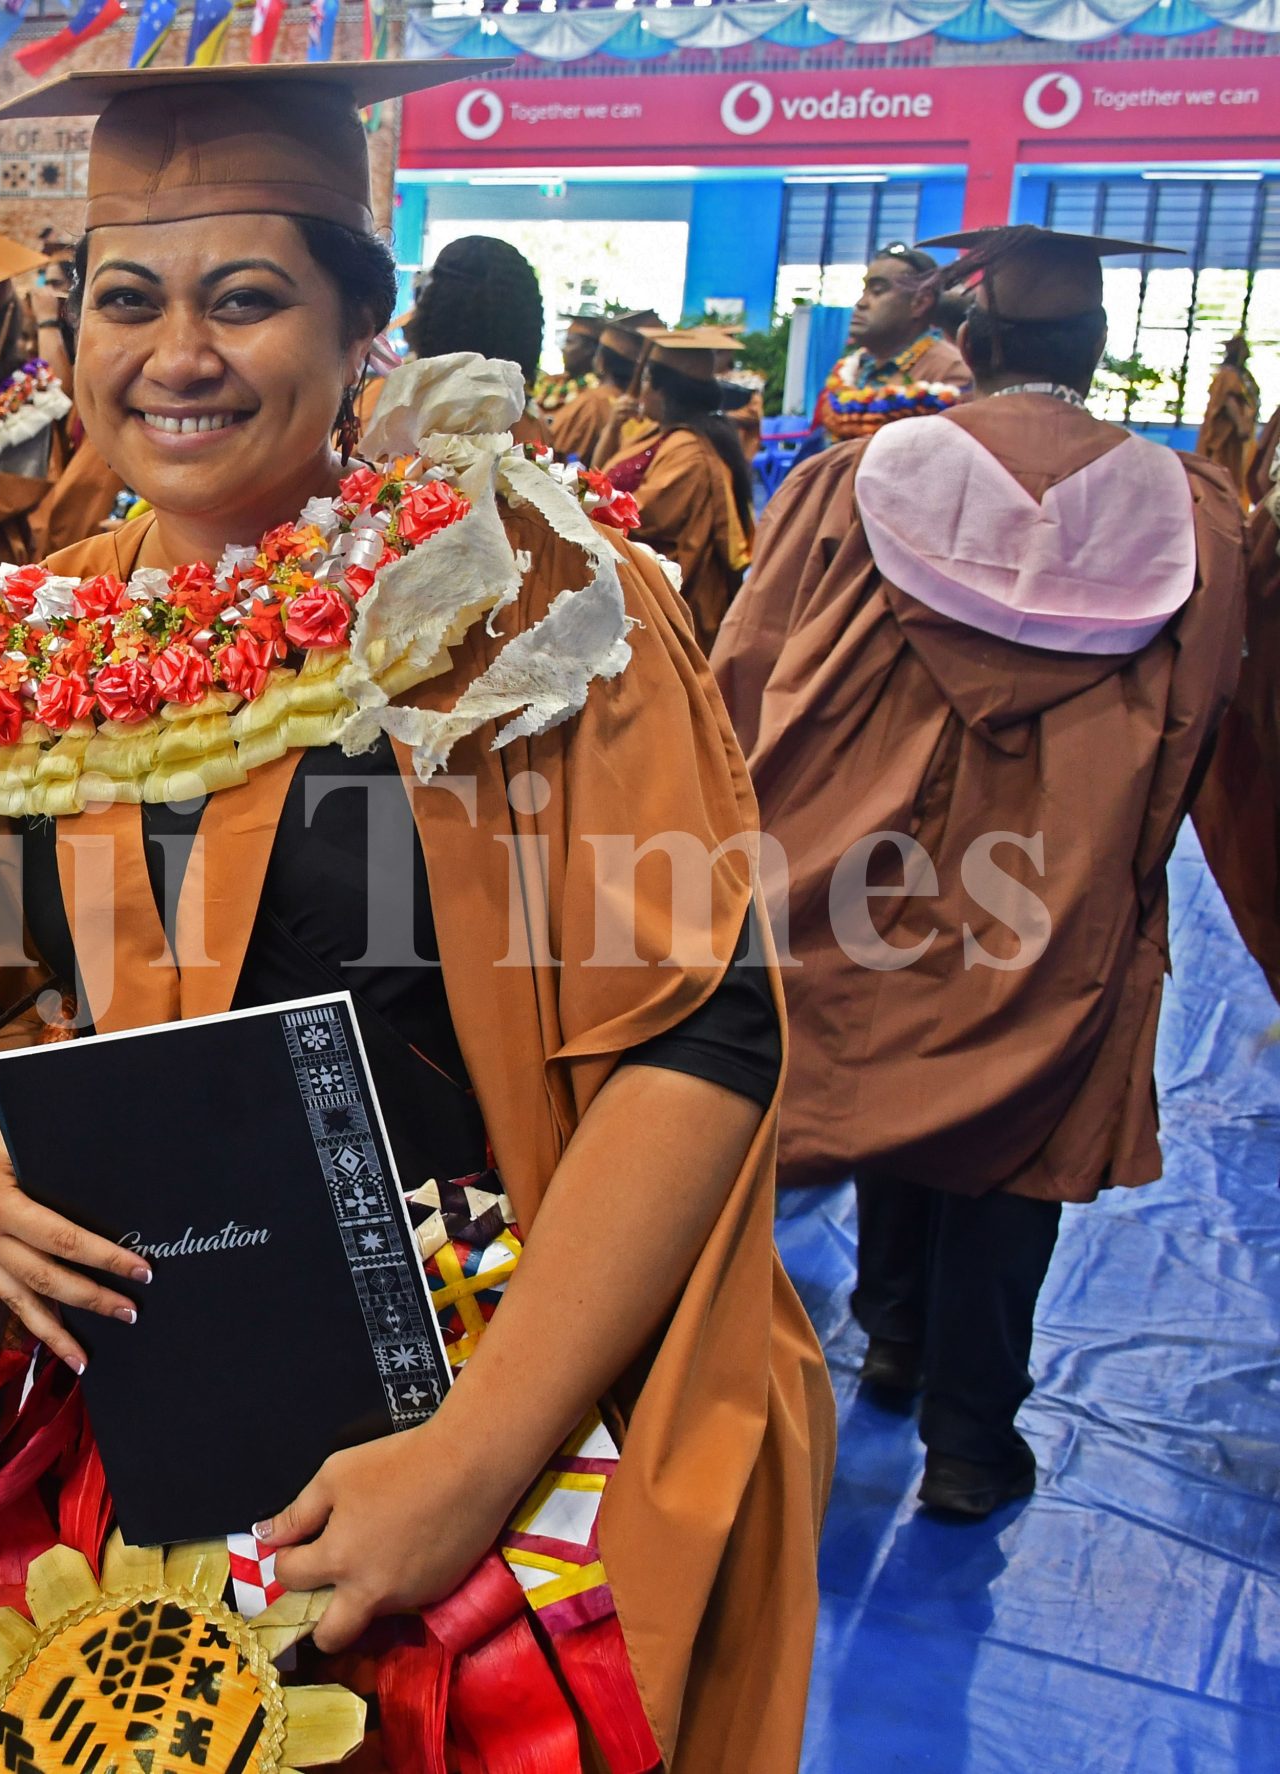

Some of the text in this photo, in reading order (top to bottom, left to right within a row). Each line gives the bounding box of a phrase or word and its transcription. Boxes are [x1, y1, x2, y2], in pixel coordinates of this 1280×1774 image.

[509, 102, 642, 124] Together we can
[781, 88, 933, 120] vodafone
[1091, 87, 1259, 111] Together we can
[117, 1220, 271, 1259] Graduation
